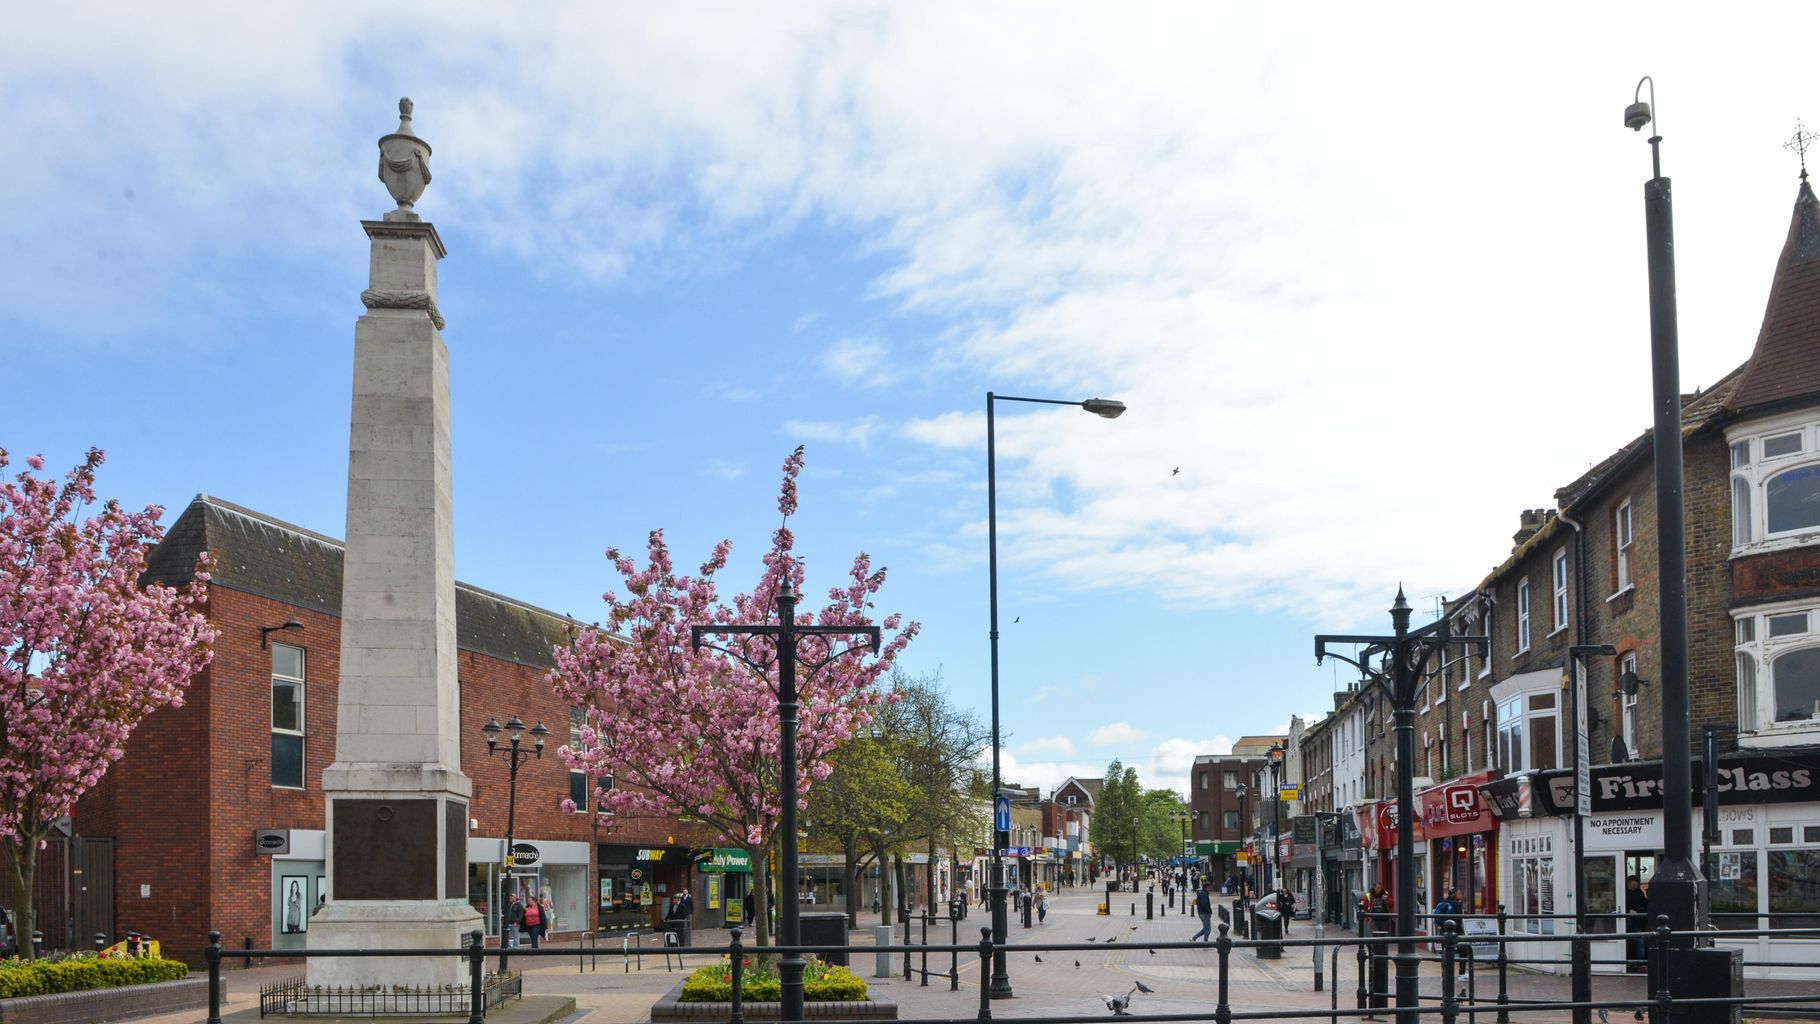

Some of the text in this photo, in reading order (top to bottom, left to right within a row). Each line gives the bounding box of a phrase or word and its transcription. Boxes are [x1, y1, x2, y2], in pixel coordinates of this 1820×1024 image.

[1597, 766, 1811, 800] Fir Class
[1451, 790, 1474, 811] Q
[1450, 811, 1479, 819] SLOTS
[1590, 817, 1654, 828] NO APPOINTMENT
[1602, 826, 1642, 835] NECESSARY
[636, 849, 663, 861] SUBWAY
[727, 854, 748, 866] Power
